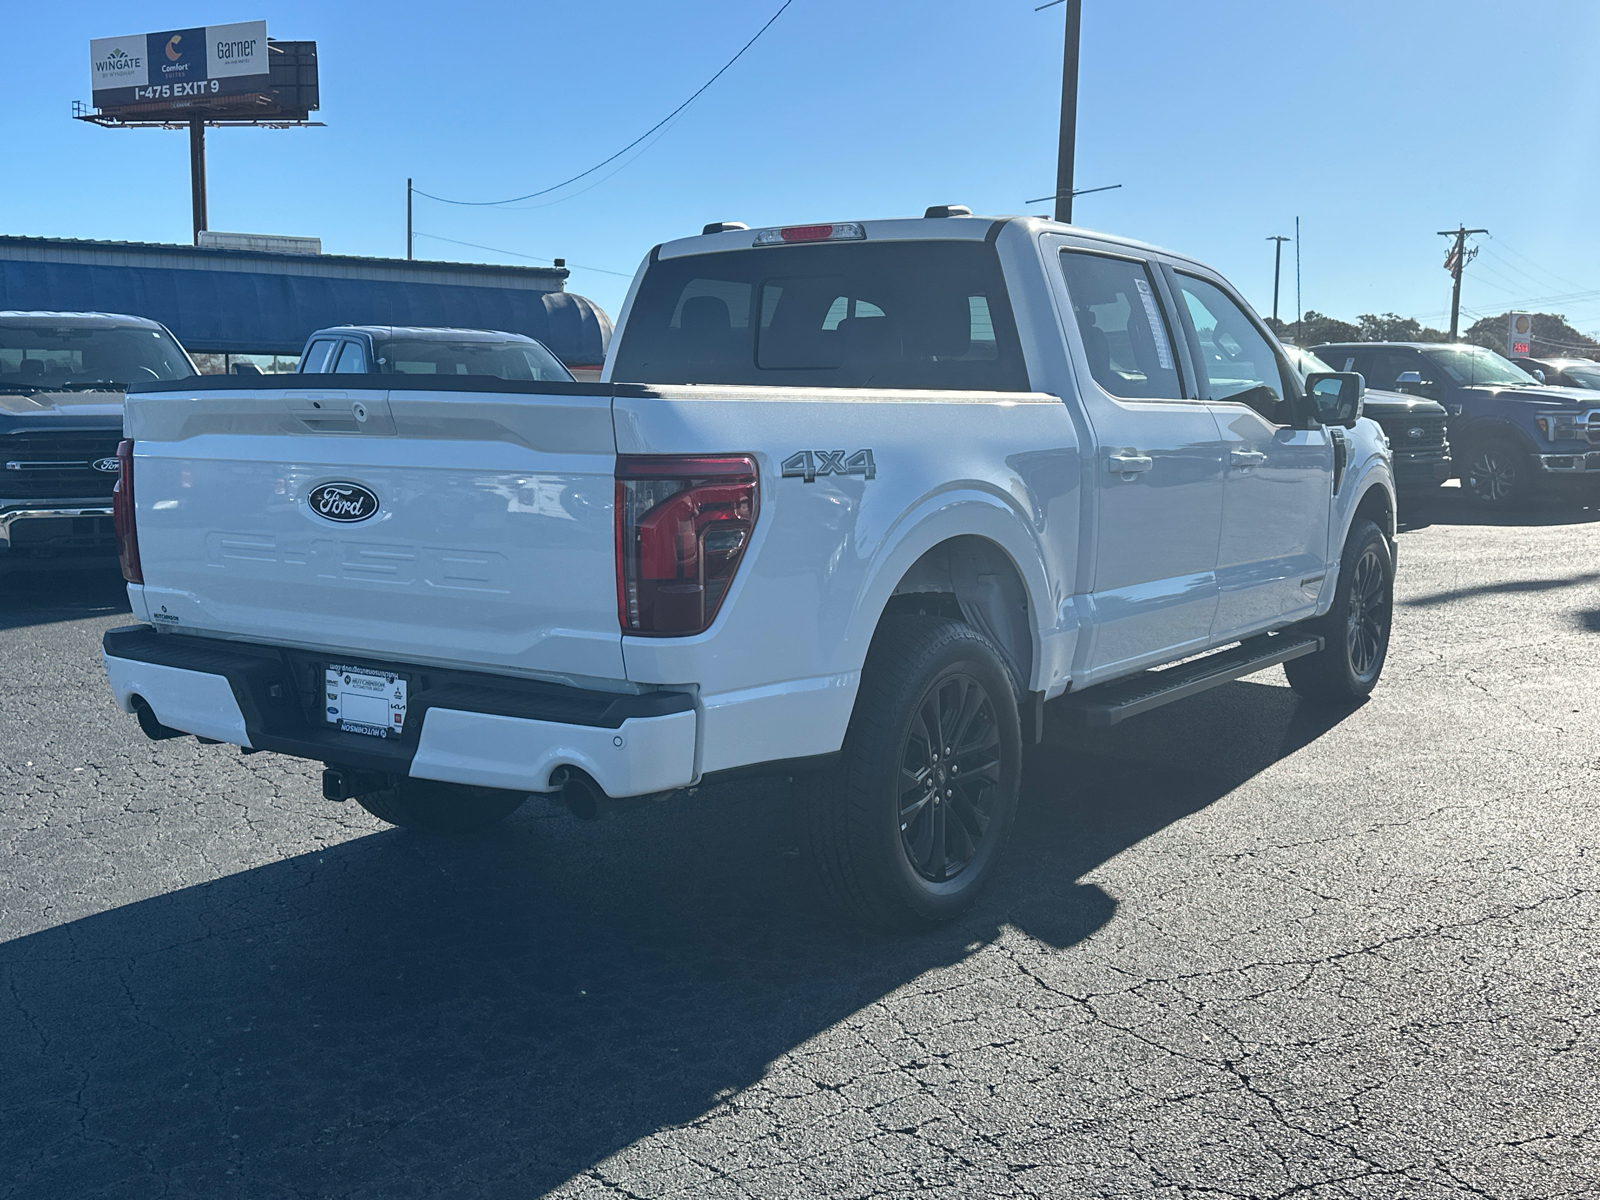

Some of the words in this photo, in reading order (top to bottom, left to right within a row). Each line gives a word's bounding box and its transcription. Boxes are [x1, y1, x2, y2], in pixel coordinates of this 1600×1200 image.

[217, 39, 257, 59] Garner
[95, 57, 141, 71] WINGATE
[161, 62, 189, 73] Comfort
[165, 71, 186, 79] SUITES
[135, 85, 170, 100] I-475
[173, 80, 208, 97] EXIT
[210, 79, 220, 93] 9
[100, 459, 119, 470] For
[781, 448, 876, 484] 4X4
[319, 487, 364, 516] Ford
[351, 677, 387, 689] HUTCHINSON
[341, 723, 380, 737] HUTCHINSON
